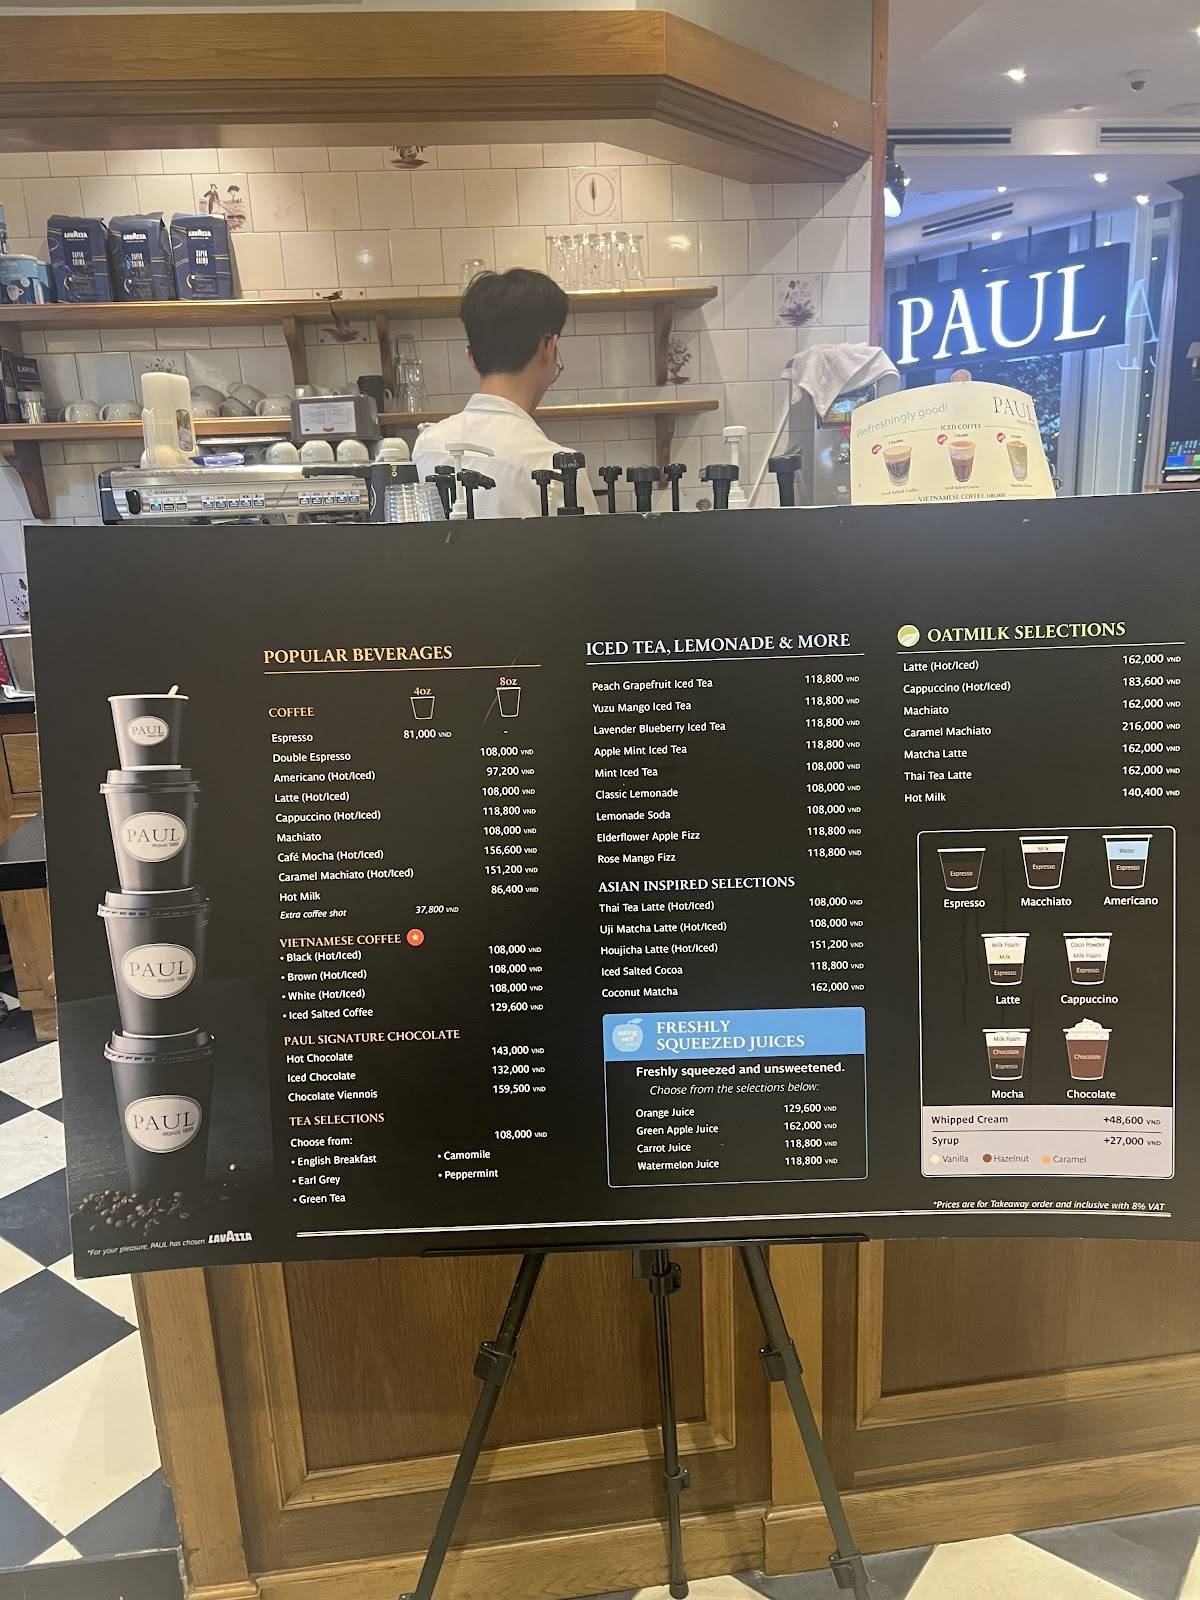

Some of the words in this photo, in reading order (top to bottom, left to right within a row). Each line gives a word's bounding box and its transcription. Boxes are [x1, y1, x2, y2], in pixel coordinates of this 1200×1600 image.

[897, 264, 1106, 365] PAUL
[993, 396, 1035, 421] PAUL
[857, 411, 915, 438] Refreshingly
[919, 402, 948, 419] good!
[918, 494, 959, 502] VIETNAMESE
[928, 627, 1010, 642] OATMILK
[1015, 622, 1125, 640] SELECTIONS
[586, 641, 628, 656] ICED
[632, 640, 671, 656] TEA,
[674, 636, 775, 653] LEMONADE
[779, 636, 793, 649] &
[798, 633, 850, 648] MORE
[264, 649, 348, 664] POPULAR
[353, 645, 452, 662] BEVERAGES
[500, 677, 518, 686] 8oz
[592, 681, 620, 691] Peach
[623, 679, 672, 691] Grapefruit
[675, 679, 694, 689] Iced
[696, 679, 713, 688] Tea
[1123, 676, 1164, 687] 183,600
[414, 687, 432, 696] 4oz
[903, 683, 960, 695] Cappuccino
[962, 681, 1011, 693] (Hot/Iced)
[268, 707, 315, 718] COFFEE
[131, 726, 164, 735] PAUL
[594, 725, 636, 735] Lavender
[639, 723, 685, 734] Blueberry
[688, 722, 707, 732] Iced
[709, 722, 726, 731] Tea
[904, 727, 943, 737] Caramel
[946, 726, 992, 736] Machiato
[1122, 721, 1163, 732] 216,000
[272, 734, 313, 744] Espresso
[404, 729, 436, 740] 81,000
[274, 773, 325, 782] Americano
[328, 771, 375, 782] (Hot/Iced)
[904, 771, 925, 781] Thai
[928, 771, 945, 780] Tea
[948, 771, 972, 780] Latte
[595, 789, 627, 799] Classic
[630, 788, 679, 799] Lemonade
[127, 829, 181, 843] PAUL
[597, 832, 650, 843] Elderflower
[652, 831, 679, 842] Apple
[682, 830, 700, 840] Fizz
[277, 852, 299, 863] Café
[302, 852, 334, 861] Mocha
[336, 850, 384, 861] (Hot/Iced)
[598, 881, 640, 893] ASIAN
[644, 879, 708, 891] INSPIRED
[711, 876, 795, 890] SELECTIONS
[944, 899, 986, 910] Espresso
[1021, 897, 1072, 906] Macchiato
[1104, 896, 1159, 905] Americano
[280, 911, 301, 920] Extra
[303, 910, 328, 918] coffee
[329, 909, 347, 917] shot
[415, 905, 445, 915] 37,800
[280, 936, 354, 948] VIETNAMESE
[357, 934, 401, 945] COFFEE
[810, 940, 848, 950] 151,200
[601, 945, 643, 957] Houjicha
[645, 945, 669, 954] Latte
[671, 943, 718, 954] (Hot/Iced)
[129, 961, 189, 977] PAUL
[996, 996, 1021, 1004] Latte
[1061, 994, 1118, 1006] Cappuccino
[289, 1010, 308, 1020] Iced
[311, 1009, 340, 1019] Salted
[343, 1007, 373, 1018] Coffee
[657, 1020, 730, 1034] FRESHLY
[284, 1035, 315, 1046] PAUL
[318, 1032, 385, 1045] SIGNATURE
[387, 1030, 460, 1042] CHOCOLATE
[657, 1036, 746, 1054] SQUEEZED
[748, 1035, 805, 1052] JUICES
[636, 1066, 678, 1078] Freshly
[681, 1064, 736, 1078] squeezed
[739, 1064, 760, 1074] and
[764, 1062, 845, 1074] unsweetened.
[650, 1086, 687, 1096] Choose
[690, 1084, 714, 1094] from
[717, 1084, 734, 1094] the
[736, 1083, 785, 1093] selections
[788, 1082, 820, 1092] below:
[992, 1090, 1024, 1099] Mocha
[1067, 1089, 1116, 1099] Chocolate
[288, 1092, 335, 1102] Chocolate
[337, 1089, 378, 1100] Viennois
[636, 1109, 669, 1119] Orange
[671, 1107, 695, 1117] Juice
[784, 1104, 822, 1114] 129,600
[133, 1111, 195, 1131] PAUL
[289, 1116, 312, 1126] TEA
[314, 1113, 385, 1125] SELECTIONS
[931, 1115, 974, 1126] Whipped
[977, 1115, 1008, 1124] Cream
[1103, 1116, 1144, 1125] +48,600
[932, 1137, 959, 1147] Syrup
[1104, 1136, 1144, 1146] +27,000
[298, 1156, 331, 1168] English
[334, 1154, 377, 1165] Breakfast
[444, 1150, 491, 1161] Camomile
[942, 1155, 969, 1163] Vanilla
[994, 1155, 1029, 1163] Hazelnut
[1053, 1155, 1087, 1164] Caramel
[637, 1160, 694, 1171] Watermelon
[696, 1159, 720, 1169] Juice
[445, 1169, 498, 1180] Peppermint
[977, 1200, 988, 1208] for
[990, 1200, 1030, 1209] Takeaway
[1031, 1200, 1053, 1208] order
[1073, 1201, 1109, 1209] inclusive
[1111, 1201, 1129, 1209] with
[1132, 1202, 1145, 1210] 8%
[102, 1248, 119, 1256] your
[119, 1244, 149, 1254] pleasure,
[208, 1230, 253, 1244] LAVAZZA
